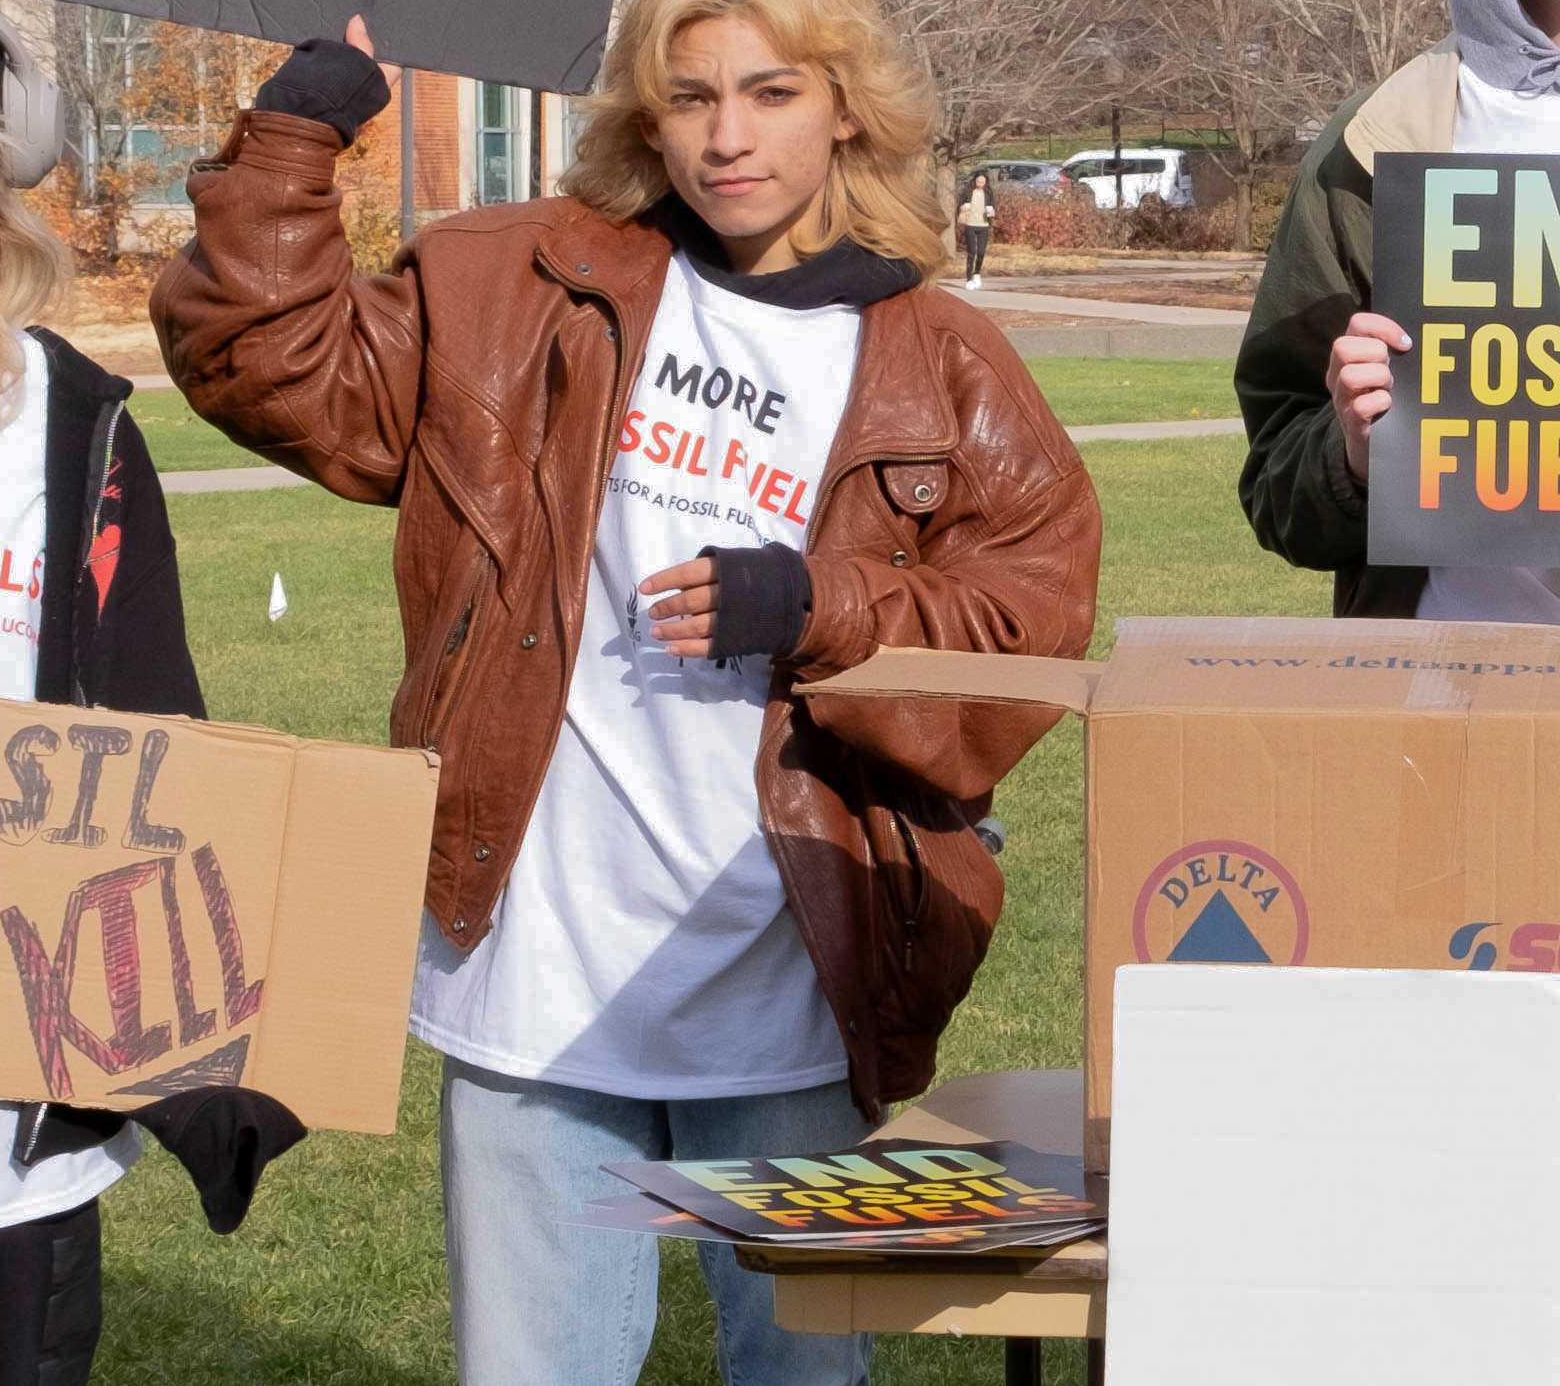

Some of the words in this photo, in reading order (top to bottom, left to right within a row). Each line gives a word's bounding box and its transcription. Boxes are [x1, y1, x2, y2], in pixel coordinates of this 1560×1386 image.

[654, 352, 787, 436] MORE
[617, 410, 709, 476] SSIL
[621, 479, 650, 501] FOR
[652, 493, 665, 509] A
[667, 495, 721, 519] FOSSIL
[1159, 852, 1282, 912] DELTA
[0, 842, 266, 1100] KILL
[666, 1148, 1007, 1192] END
[720, 1175, 1060, 1211] FOSSIL
[759, 1193, 1098, 1229] FUELS
